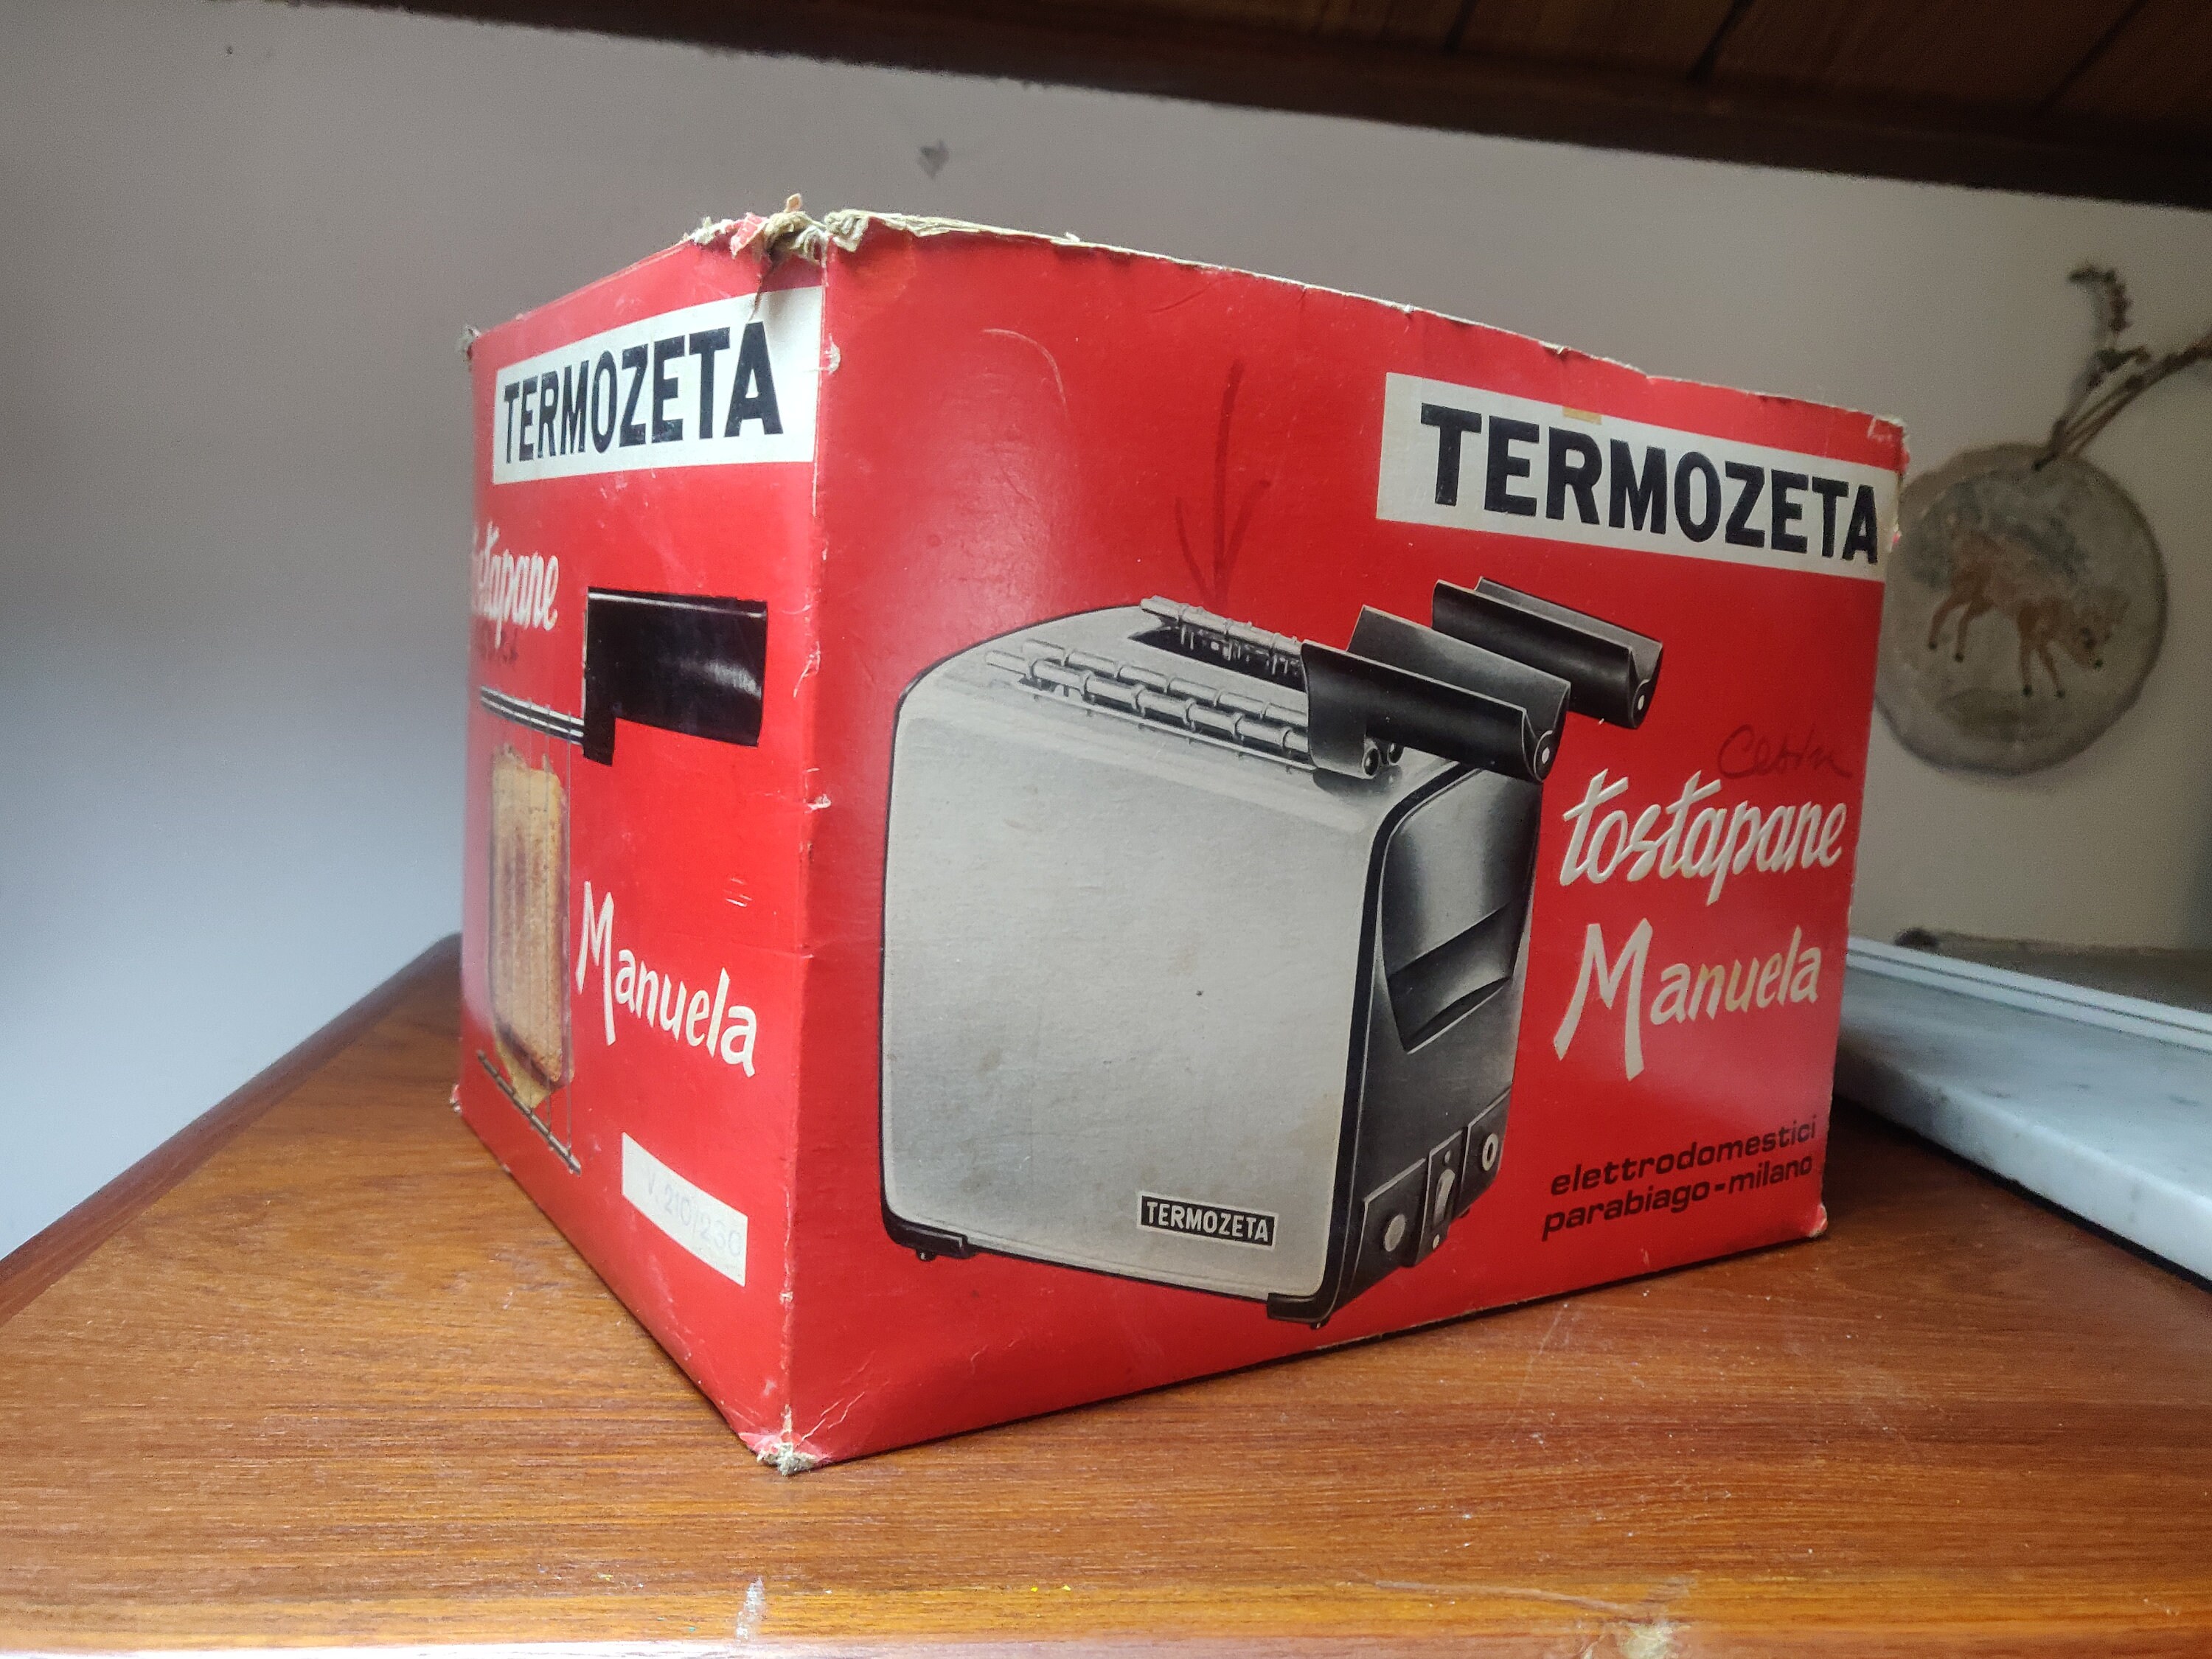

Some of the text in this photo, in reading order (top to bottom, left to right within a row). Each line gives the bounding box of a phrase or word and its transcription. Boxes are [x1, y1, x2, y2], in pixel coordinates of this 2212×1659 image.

[504, 321, 784, 464] TERMOZETA
[1421, 403, 1878, 565] TERMOZETA
[1559, 768, 1847, 906] tostapane
[575, 880, 757, 1077] Manuela
[1554, 917, 1822, 1082] Manuela
[1147, 1201, 1269, 1242] TERMOZETA
[1551, 1114, 1817, 1195] elettrodomestici
